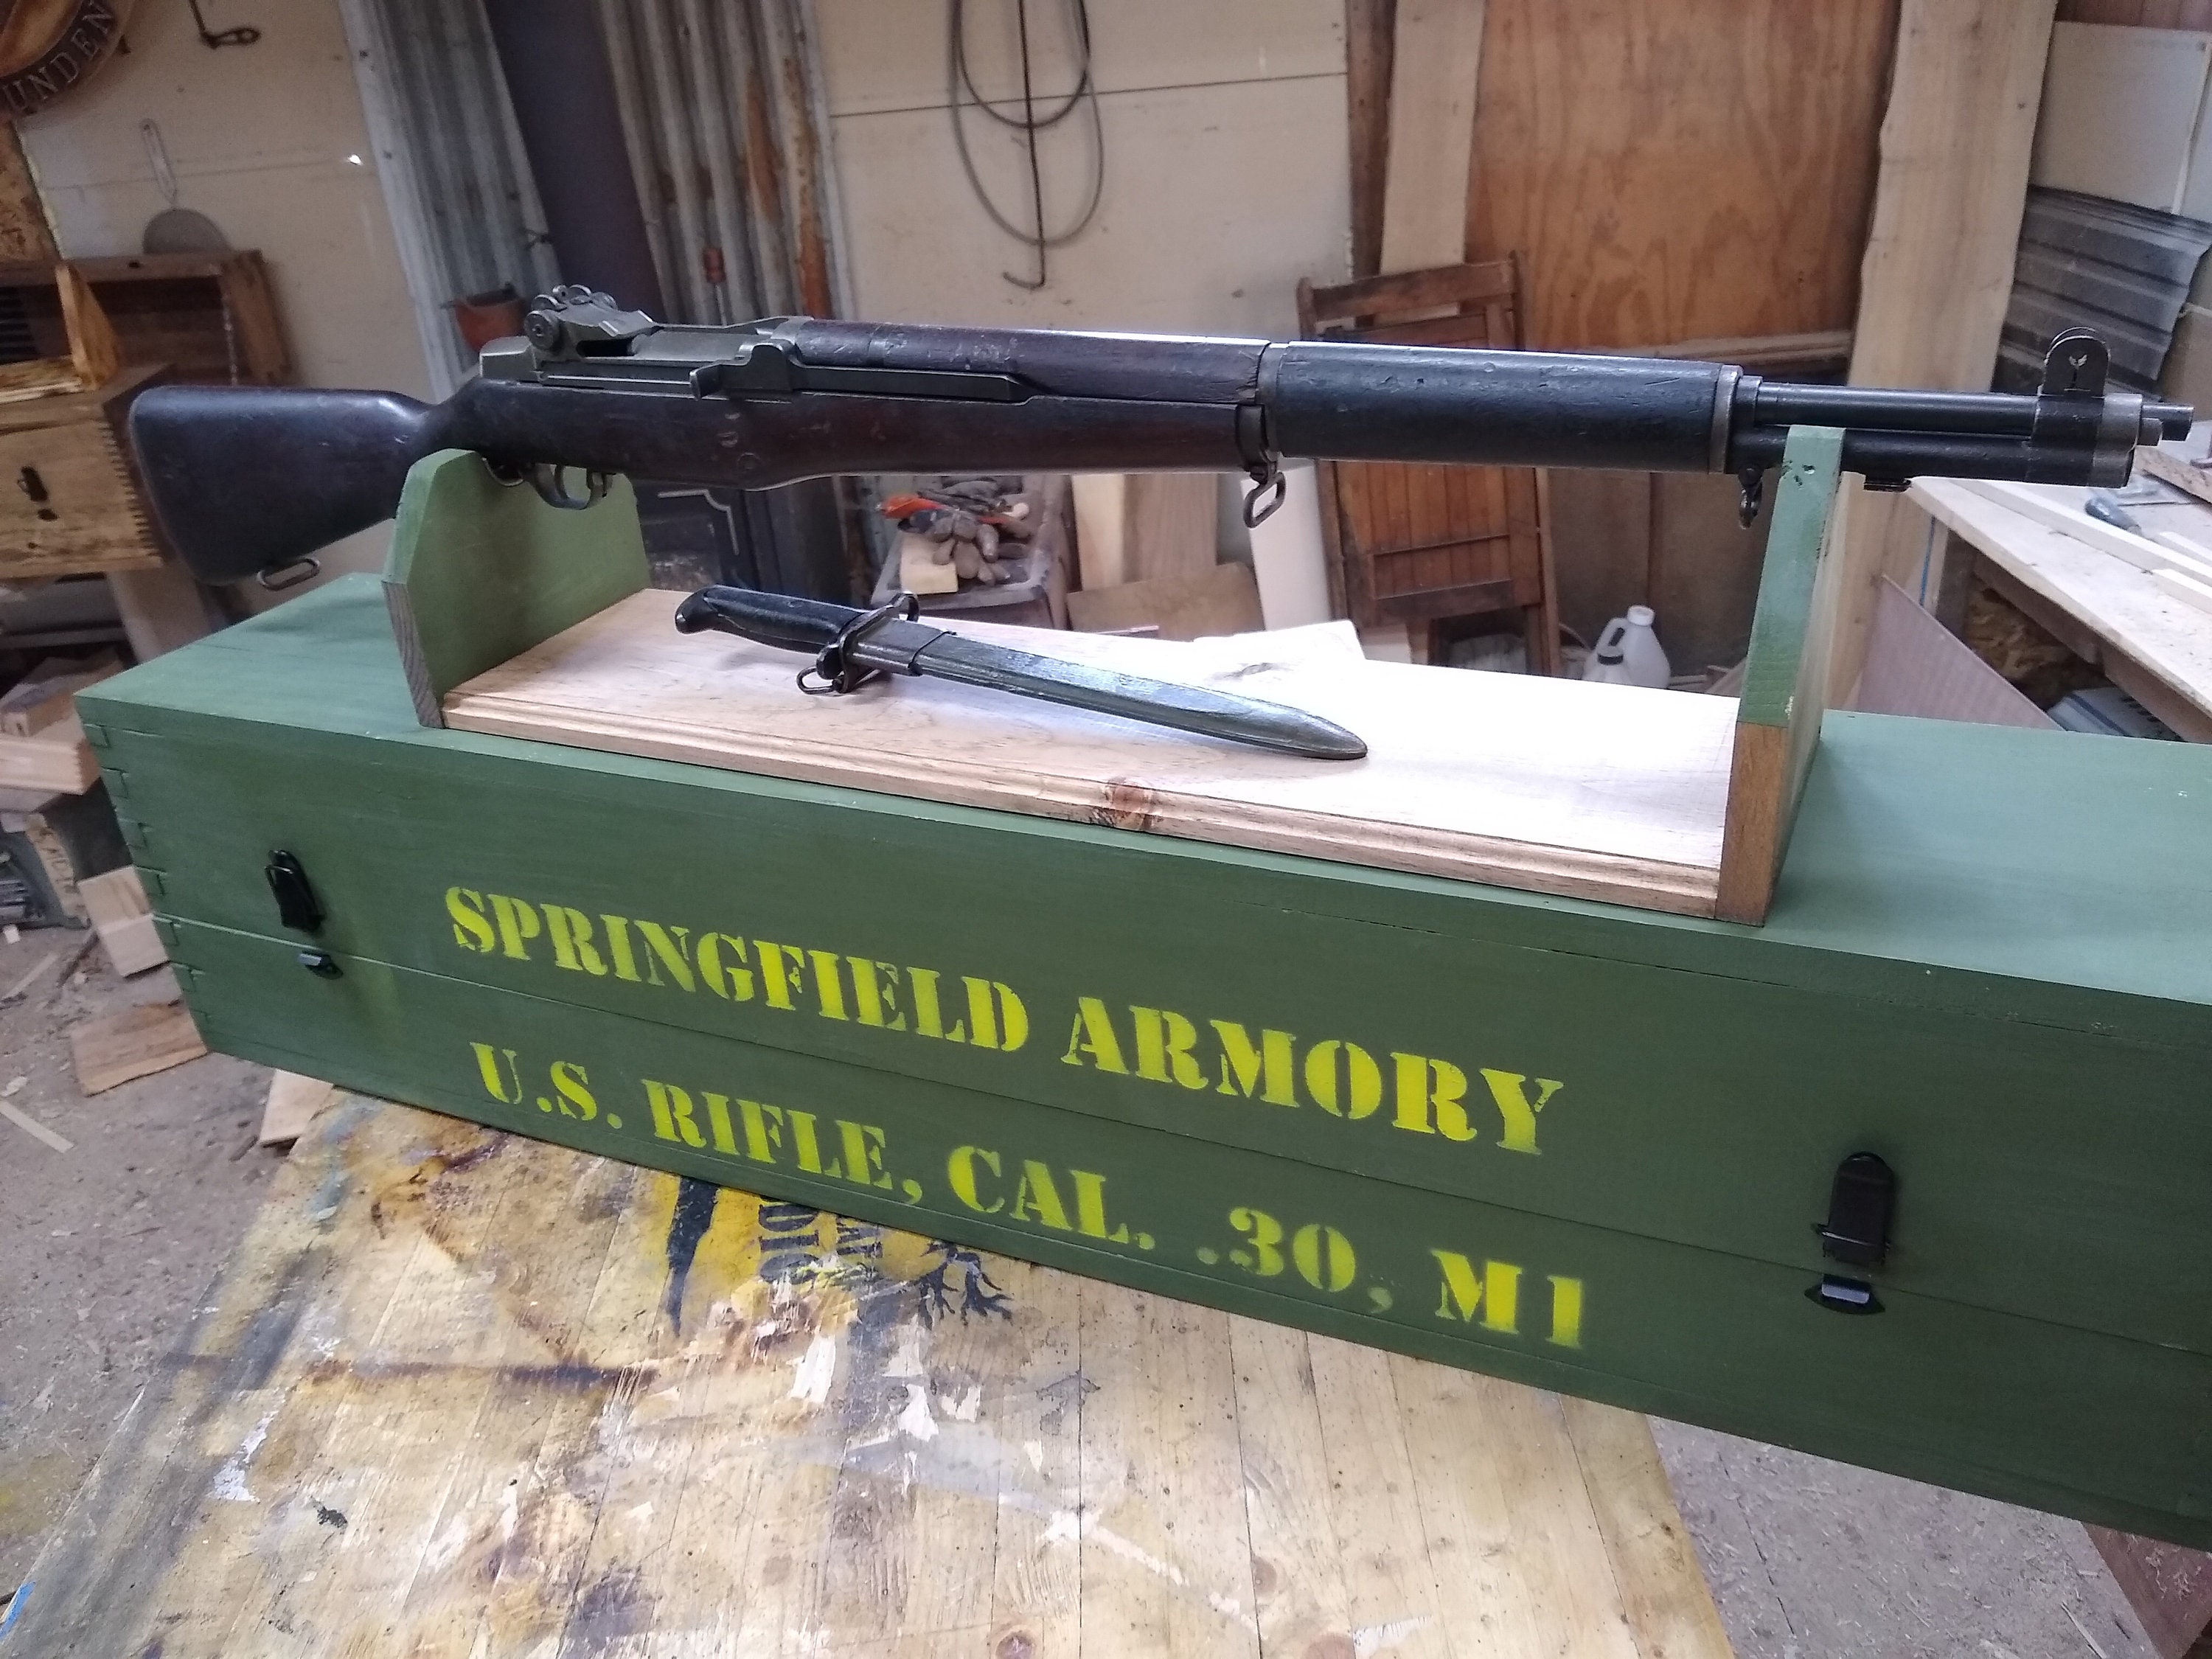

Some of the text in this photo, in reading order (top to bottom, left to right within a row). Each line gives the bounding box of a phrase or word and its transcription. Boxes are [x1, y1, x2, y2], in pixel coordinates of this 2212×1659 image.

[445, 886, 1564, 1155] SPRINGFIELD ARMORY
[470, 1042, 622, 1130] U.S.
[641, 1079, 923, 1205] RIFLE,
[947, 1145, 1156, 1250] CAL.
[1196, 1206, 1394, 1314] .30,
